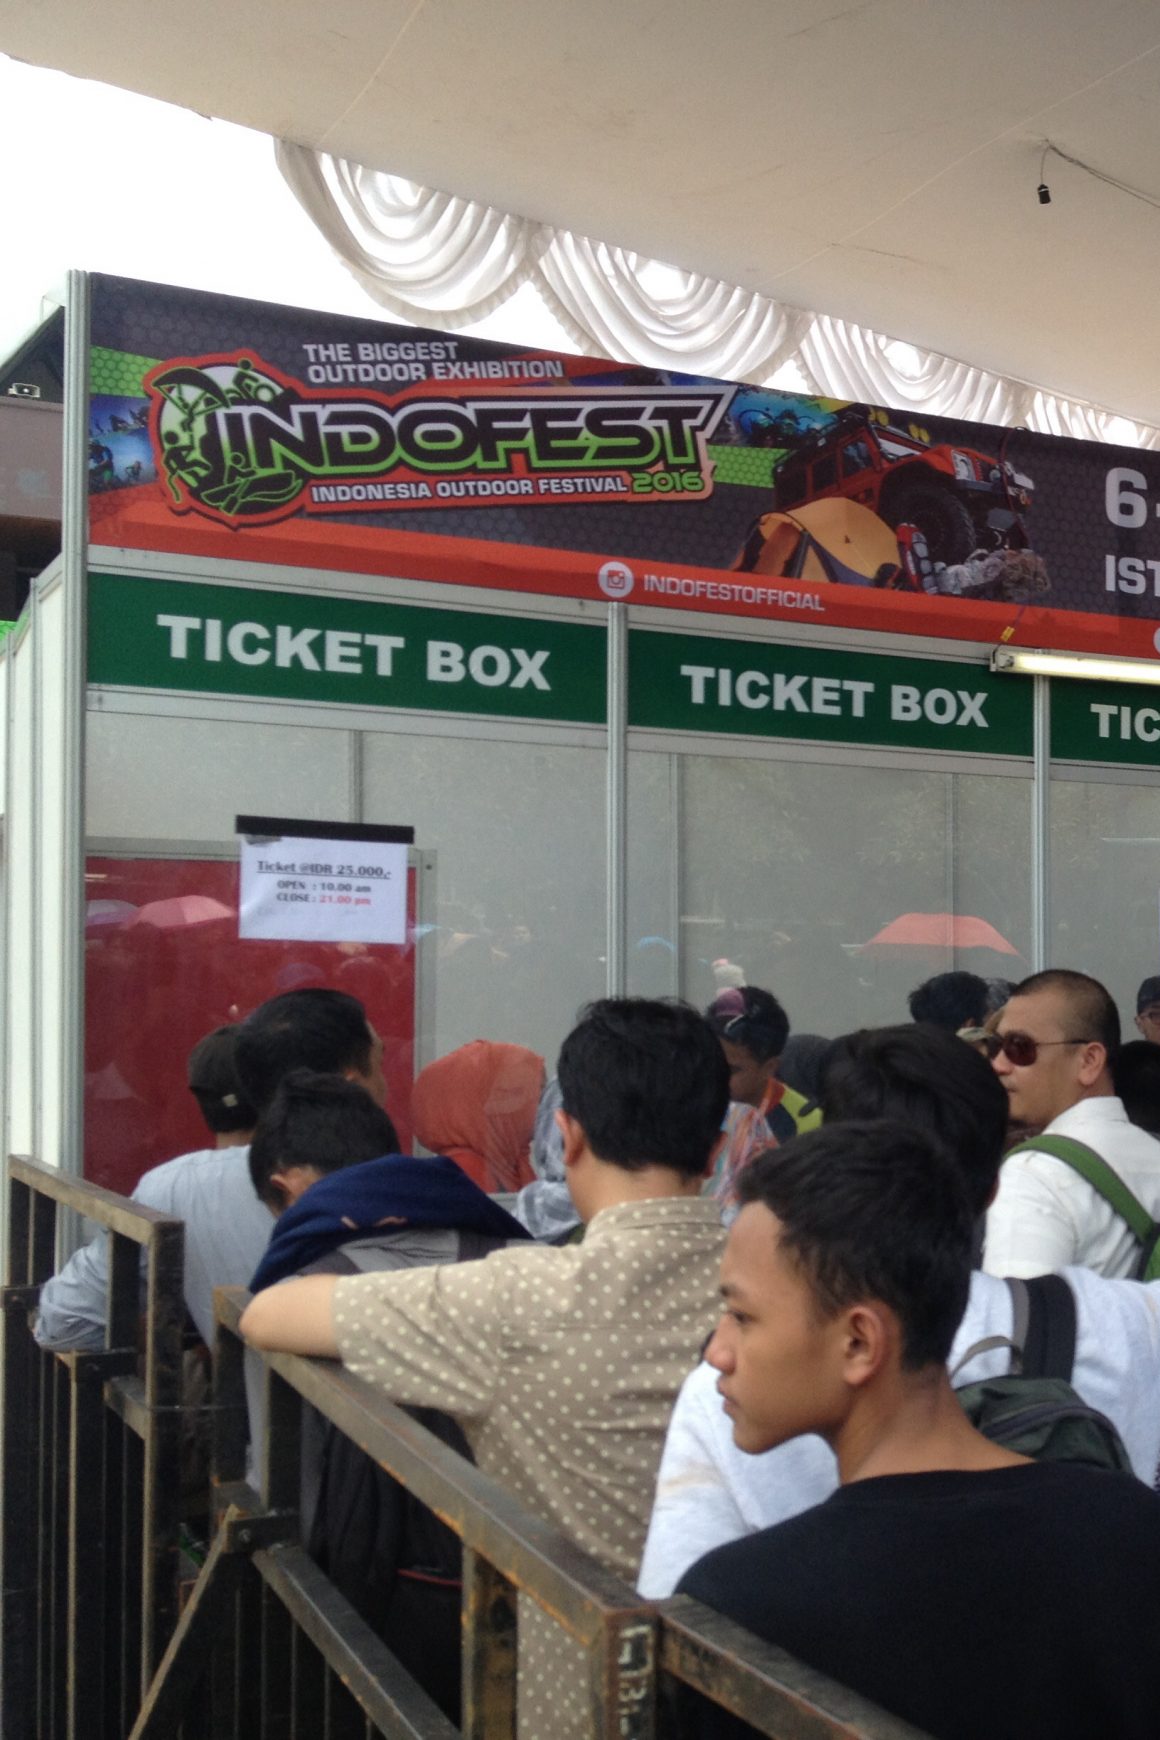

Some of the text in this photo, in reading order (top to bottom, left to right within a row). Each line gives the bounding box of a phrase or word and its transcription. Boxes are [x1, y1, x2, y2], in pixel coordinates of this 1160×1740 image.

[303, 342, 458, 362] THE BIGGEST
[307, 360, 563, 383] OUTDOOR EXHIBITION
[214, 400, 710, 474] INDOFEST
[312, 471, 704, 502] INDONESIA OUTDOOR FESTIVAL 2016
[643, 574, 825, 611] INDOFESTOFFICIAL
[157, 614, 551, 691] TICKET BOX
[680, 664, 989, 728] TICKET BOX
[257, 860, 296, 873] Ticket
[277, 880, 306, 889] OPEN
